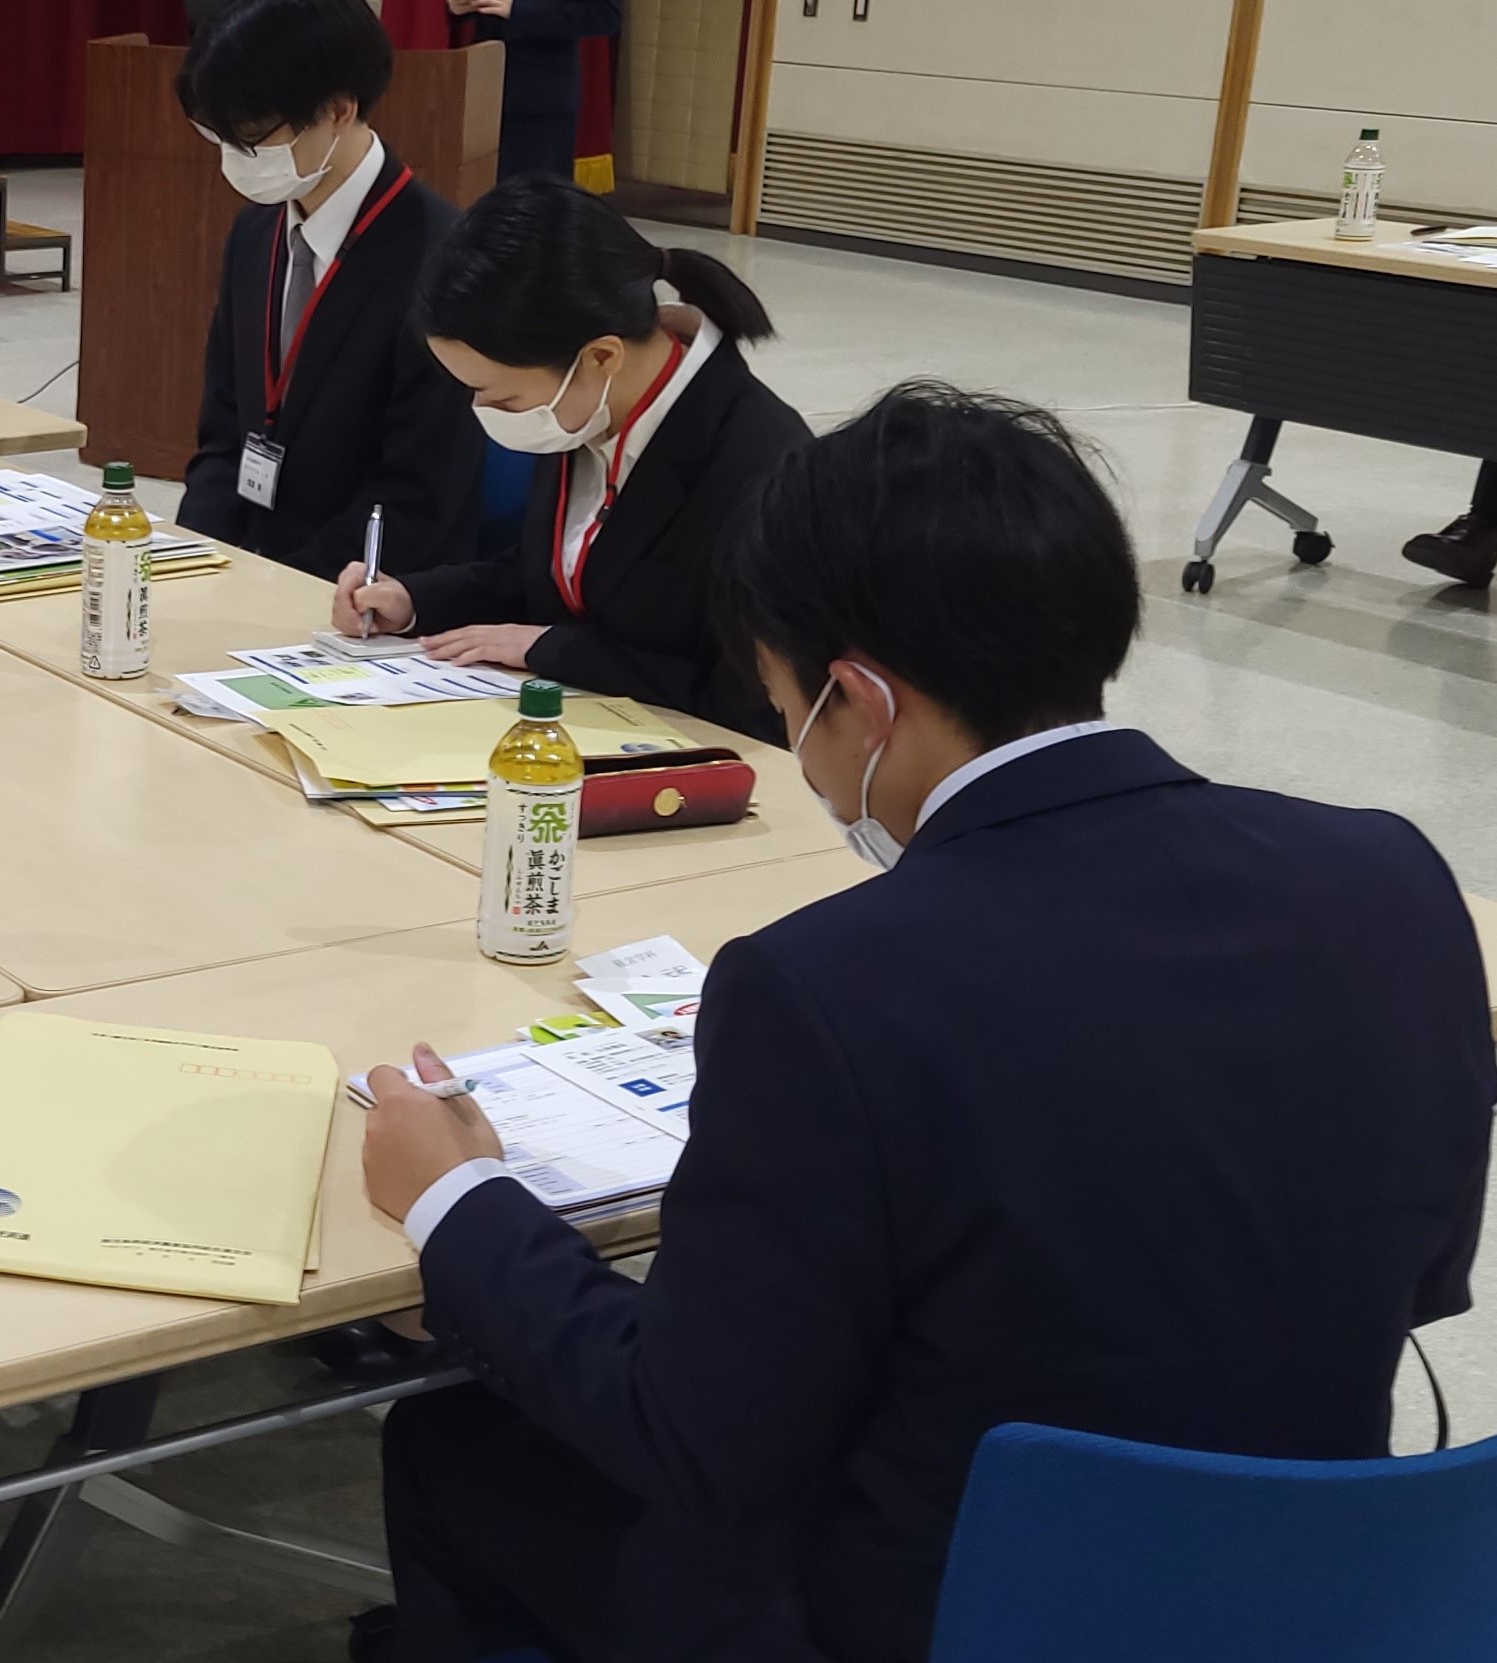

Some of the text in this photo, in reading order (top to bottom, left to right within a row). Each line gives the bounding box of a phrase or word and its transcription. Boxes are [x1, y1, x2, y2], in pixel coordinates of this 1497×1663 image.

[527, 802, 571, 844] 茶
[523, 849, 546, 915] 眞煎茶
[545, 849, 566, 914] かごしま
